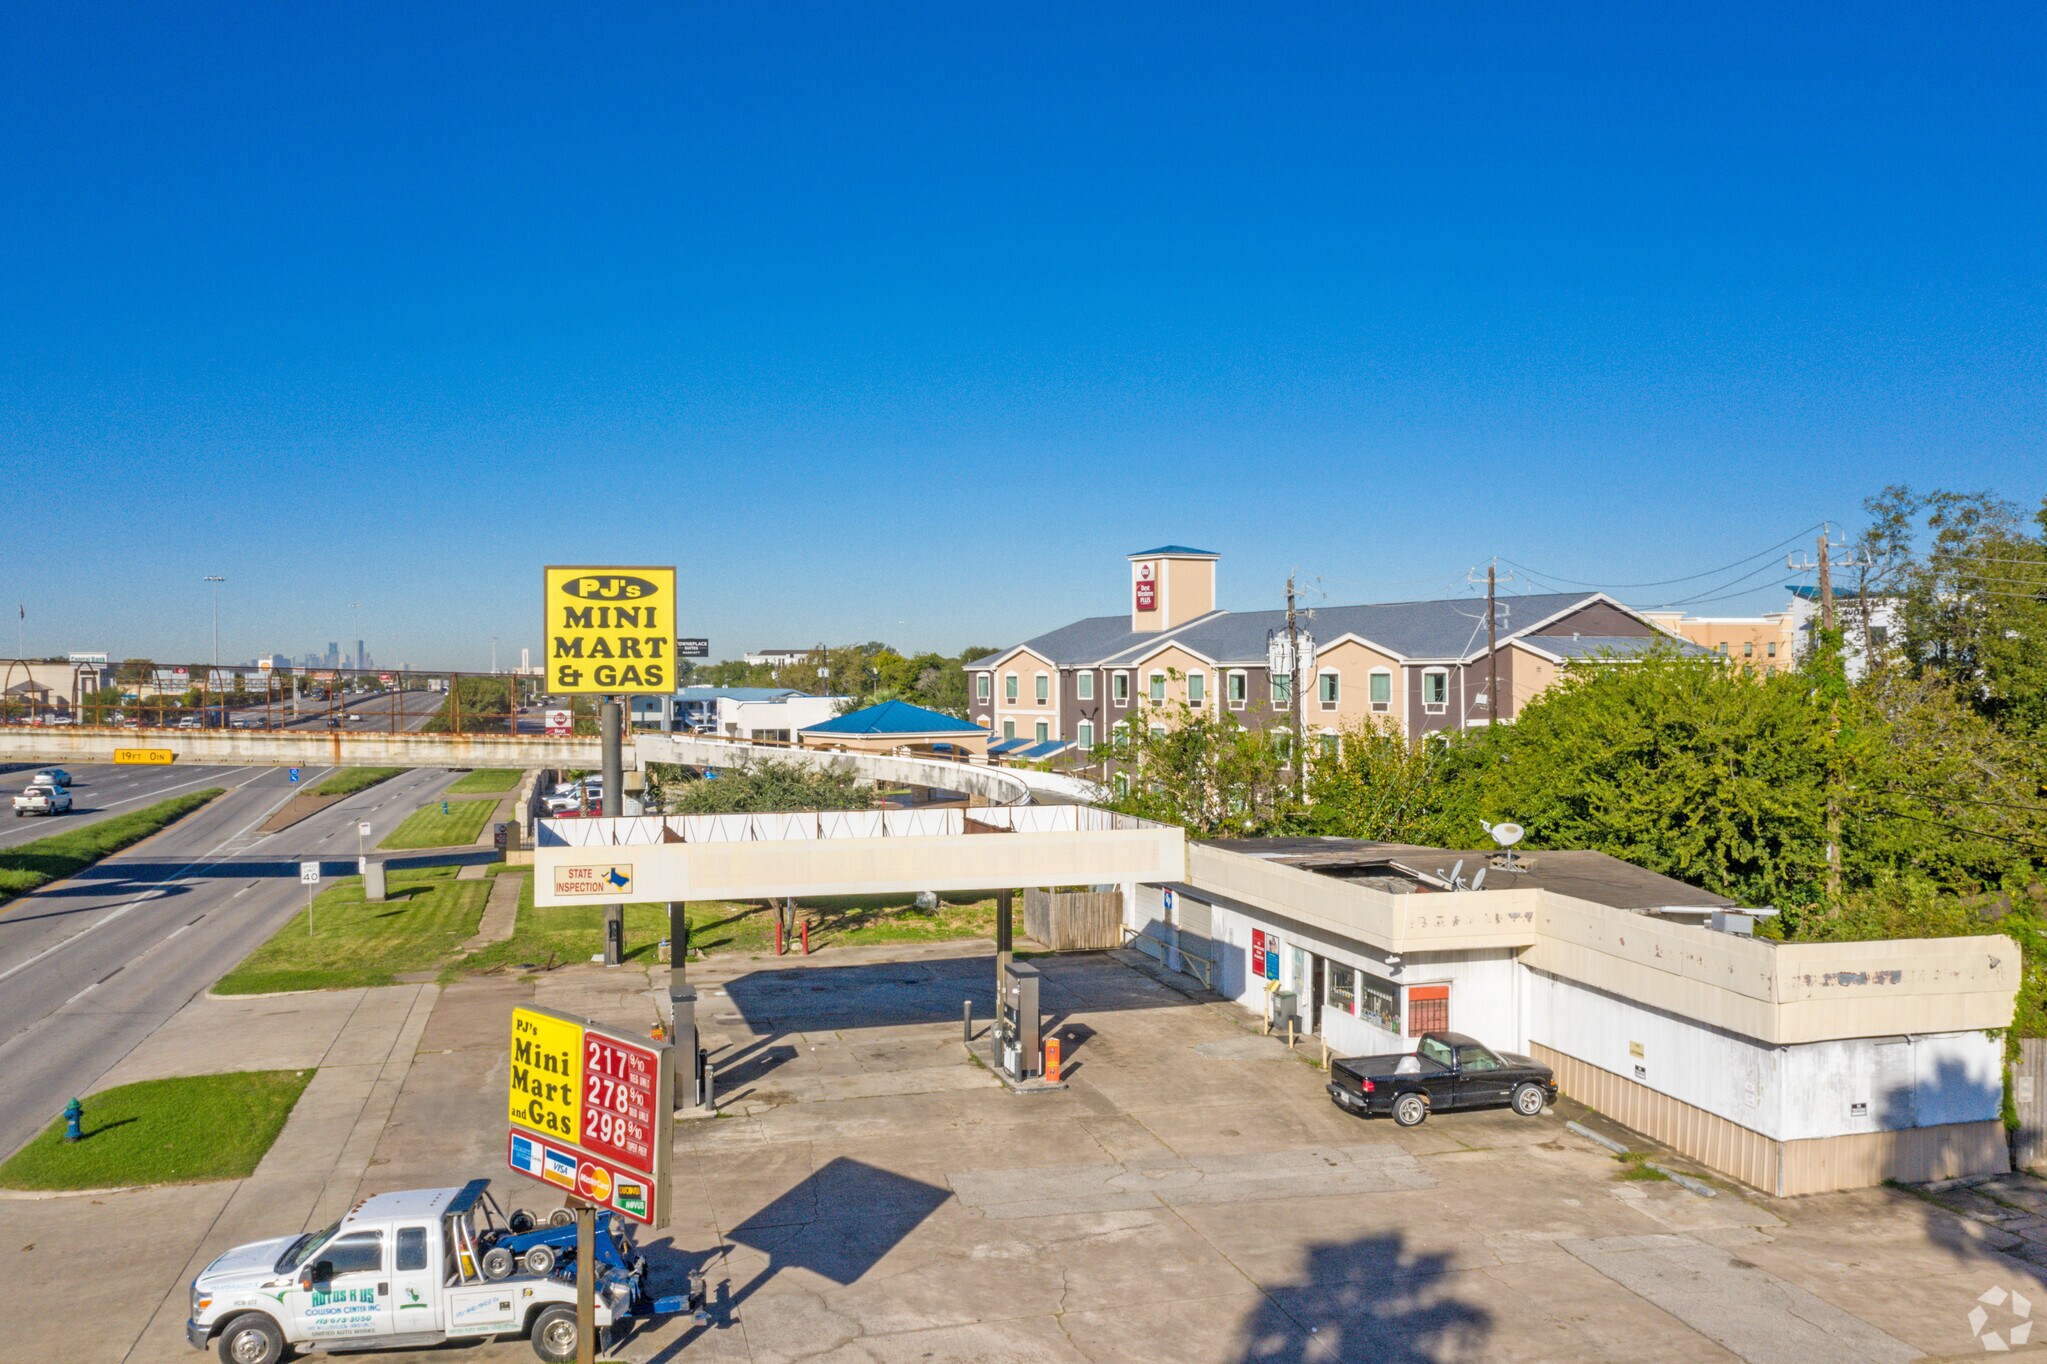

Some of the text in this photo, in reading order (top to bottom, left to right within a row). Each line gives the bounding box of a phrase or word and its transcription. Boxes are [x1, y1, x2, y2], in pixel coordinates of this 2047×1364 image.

[578, 578, 641, 598] PJ's
[563, 606, 657, 628] MINI
[553, 636, 668, 659] MART
[558, 664, 664, 687] & GAS
[303, 873, 318, 881] 40
[568, 868, 593, 879] STATE
[556, 882, 604, 893] INSPECTION
[516, 1019, 538, 1036] PJ's
[515, 1037, 570, 1077] Mini
[589, 1042, 627, 1079] 217
[512, 1065, 572, 1107] Mart
[588, 1075, 629, 1114] 278
[511, 1099, 571, 1135] and Gas
[586, 1109, 626, 1148] 298
[553, 1162, 568, 1176] VISA
[580, 1173, 609, 1190] MasterCard
[625, 1200, 645, 1210] NOVUS
[360, 1288, 374, 1303] US
[305, 1308, 342, 1317] COLLISION
[343, 1306, 366, 1314] CENTER
